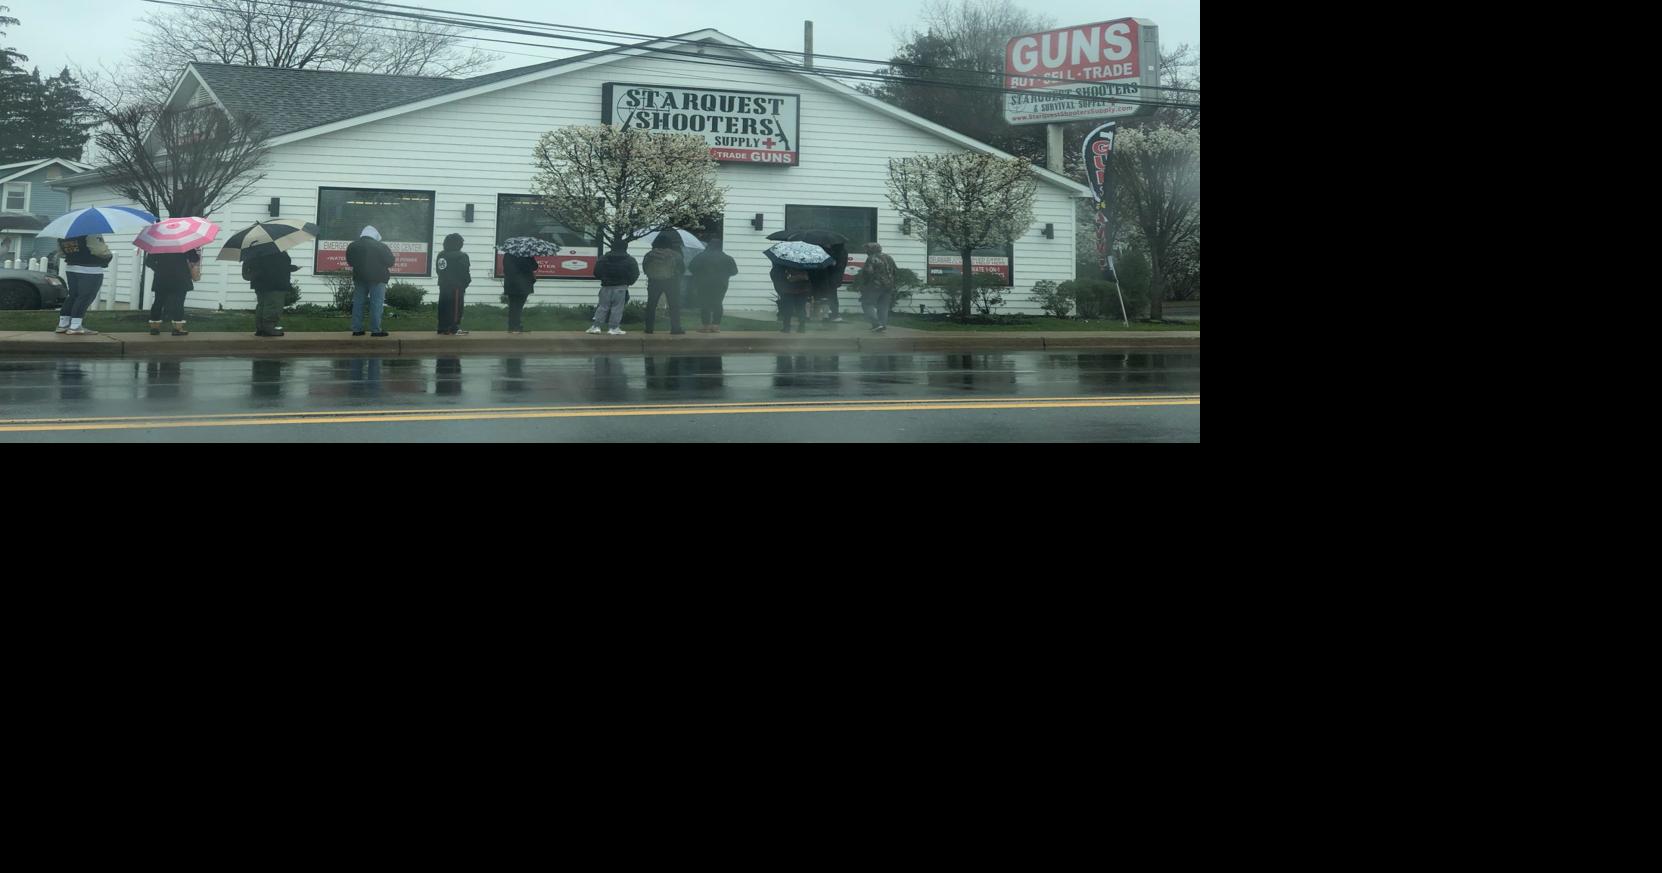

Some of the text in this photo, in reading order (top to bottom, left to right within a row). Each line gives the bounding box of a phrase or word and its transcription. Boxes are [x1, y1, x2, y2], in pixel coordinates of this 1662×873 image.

[1012, 22, 1132, 73] GUNS
[1083, 63, 1133, 80] TRADE
[1075, 82, 1138, 98] SHOOTERS
[626, 89, 784, 115] STARQUEST
[1041, 101, 1075, 112] SURVIVAL
[635, 111, 774, 136] SHOOTERS
[715, 136, 760, 148] SUPPLY
[717, 151, 792, 163] TRADE GUNS
